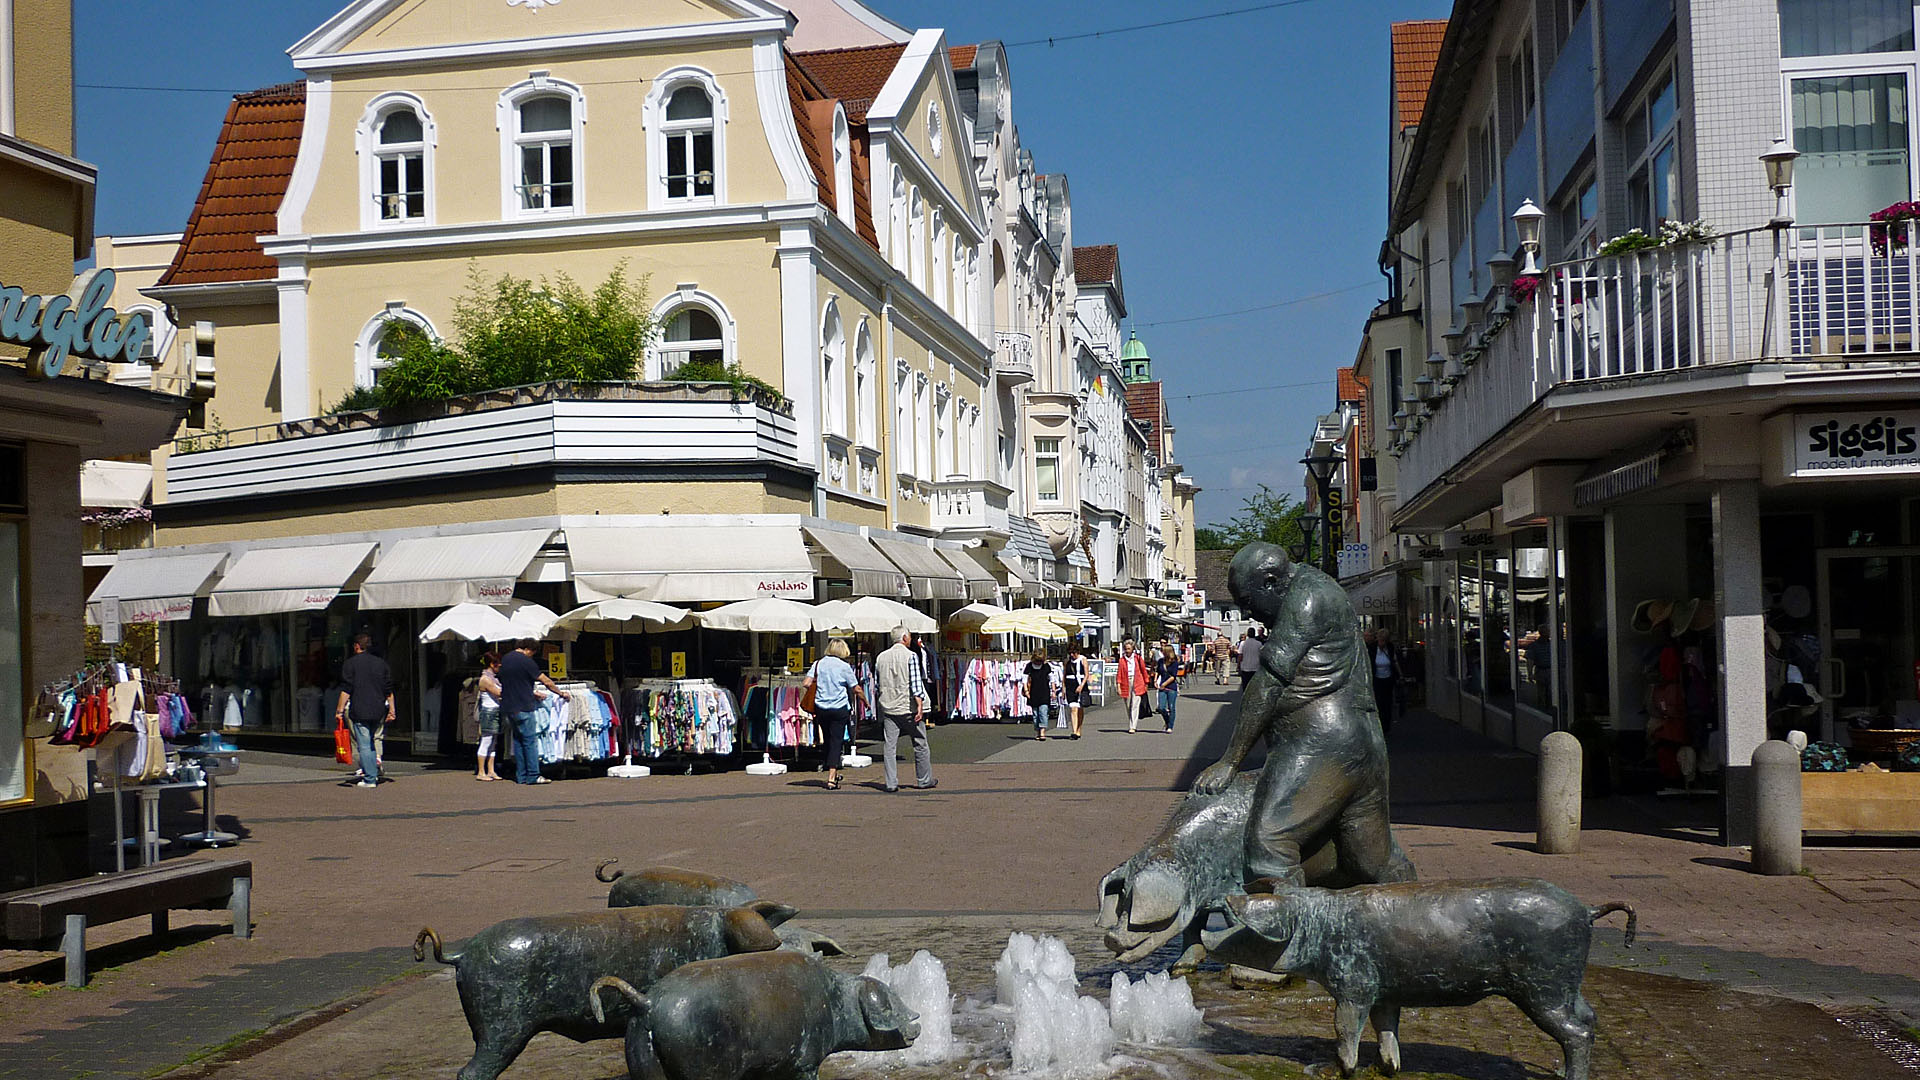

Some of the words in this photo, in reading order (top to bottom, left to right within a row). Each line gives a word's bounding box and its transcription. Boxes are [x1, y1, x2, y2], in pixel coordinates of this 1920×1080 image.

[0, 267, 150, 380] uglas
[1808, 459, 1847, 470] mode
[1871, 456, 1920, 469] männe
[757, 579, 808, 591] Asialand
